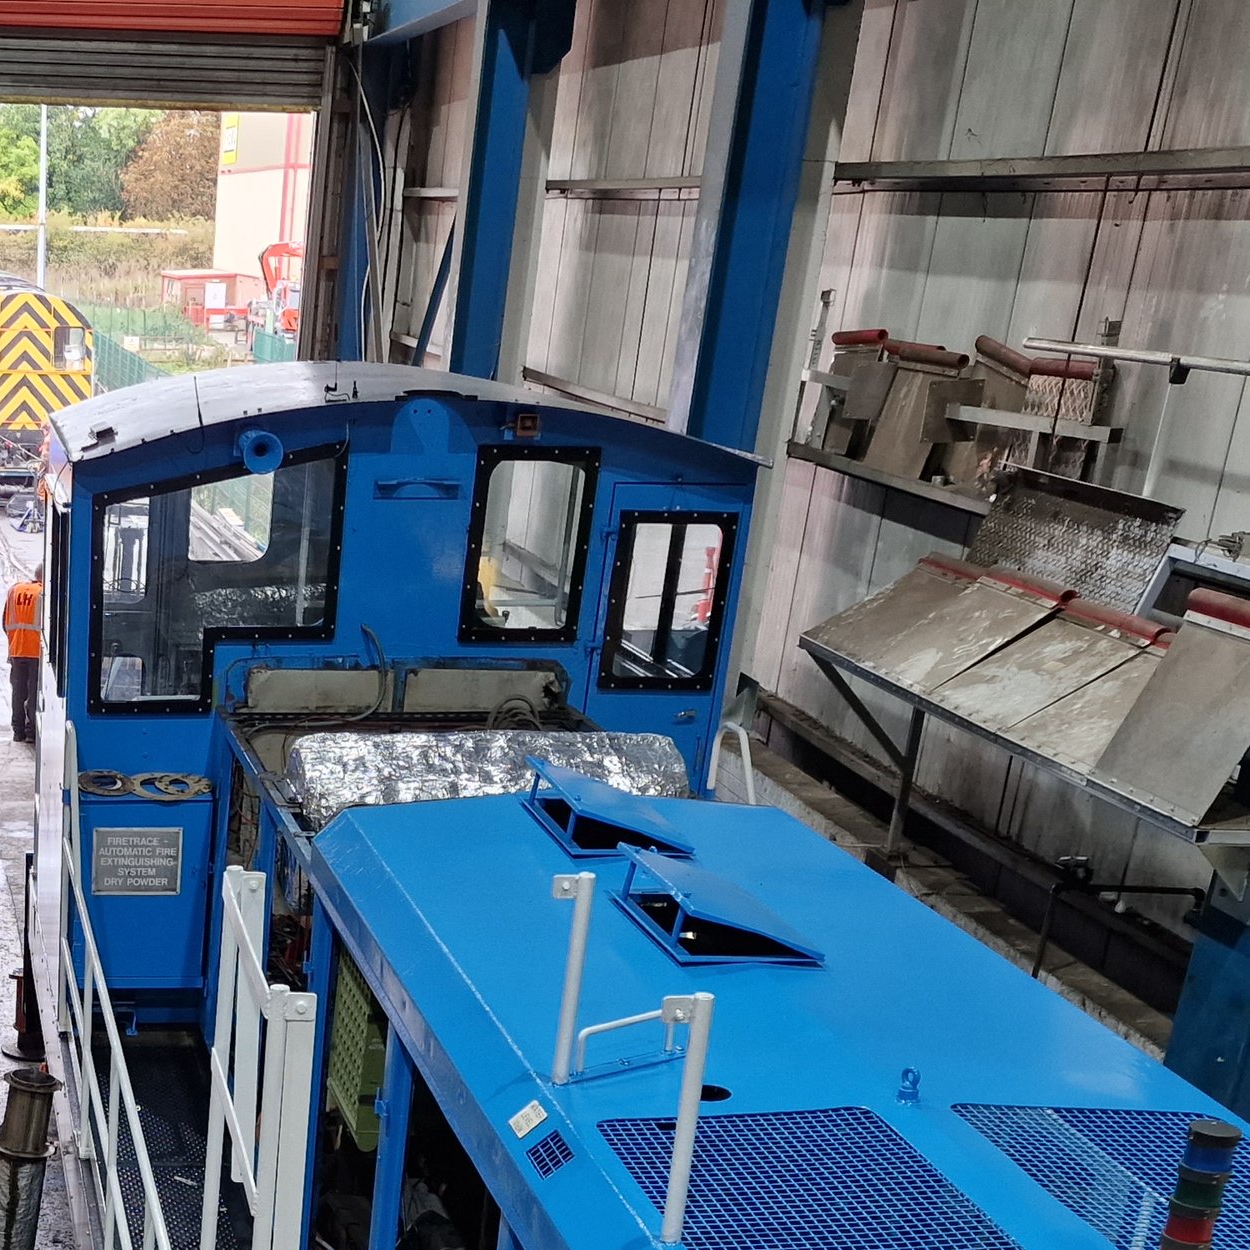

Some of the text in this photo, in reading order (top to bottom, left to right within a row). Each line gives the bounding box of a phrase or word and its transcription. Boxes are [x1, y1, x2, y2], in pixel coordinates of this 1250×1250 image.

[107, 837, 160, 846] FIRETRACE
[99, 847, 177, 856] AUTOMATIC FIRE
[117, 867, 156, 876] SYSTEM
[104, 877, 168, 886] DRY POWDER
